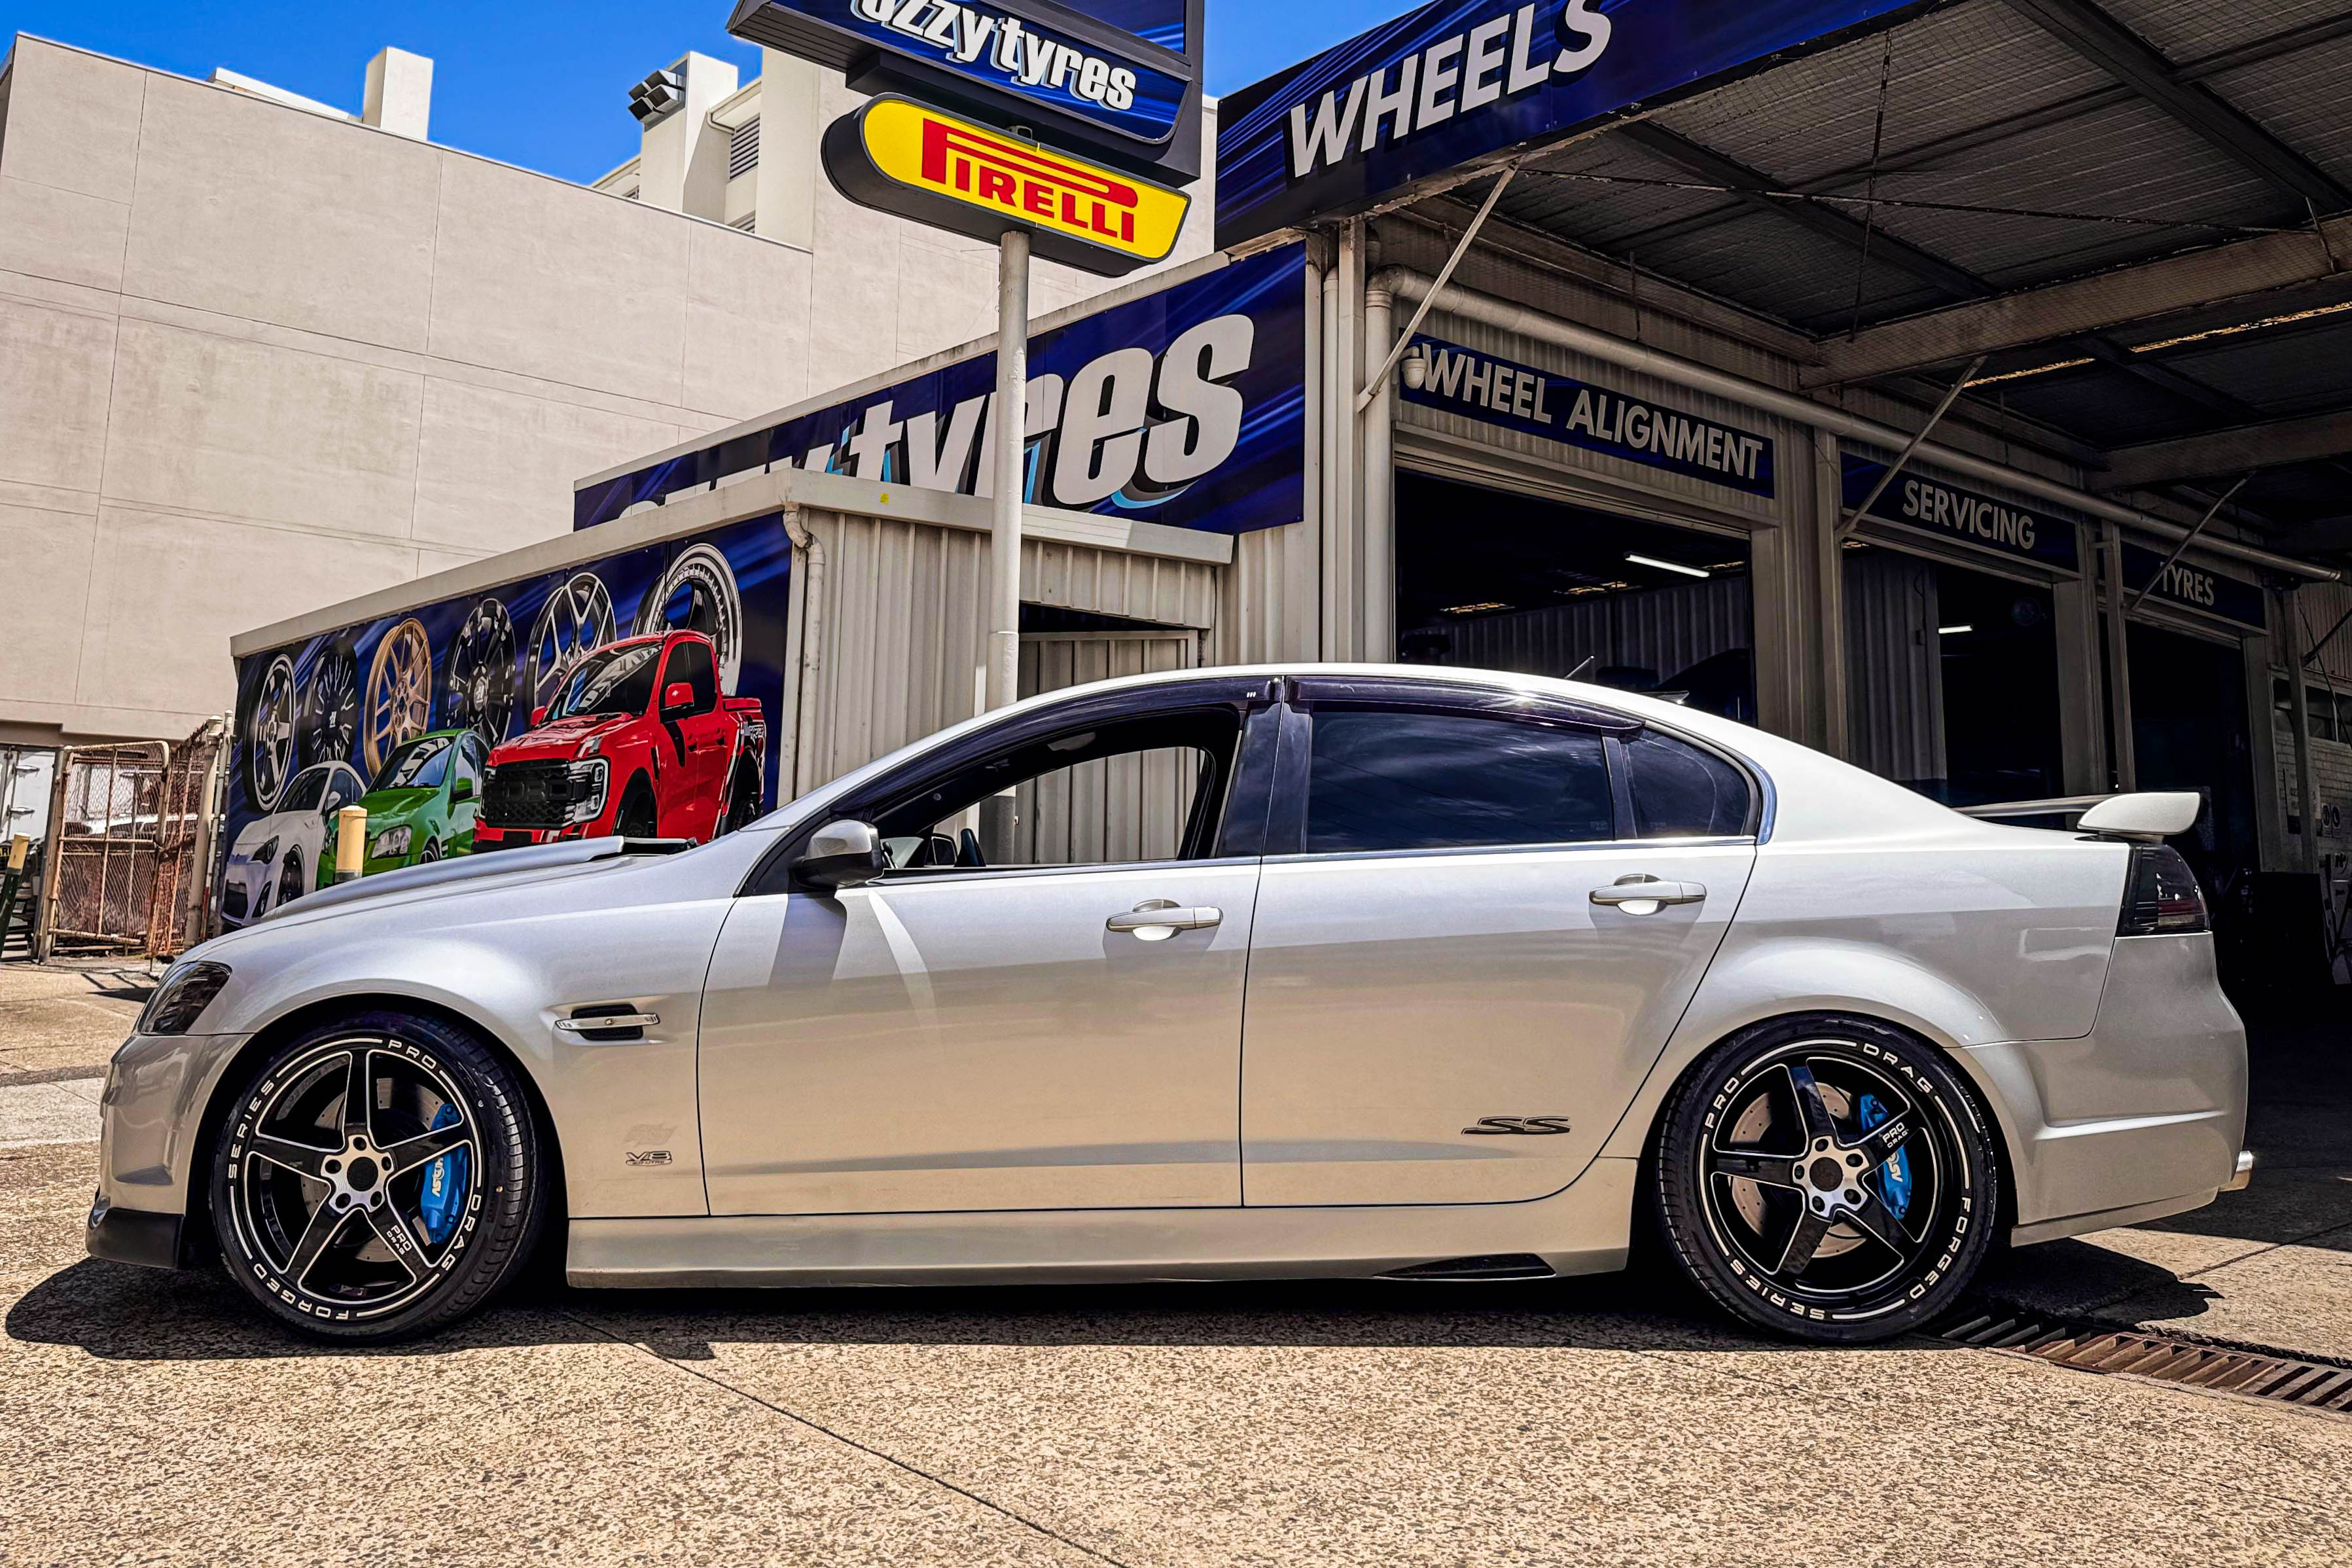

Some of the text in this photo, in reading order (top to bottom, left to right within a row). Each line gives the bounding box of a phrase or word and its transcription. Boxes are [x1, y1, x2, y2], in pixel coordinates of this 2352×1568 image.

[1291, 0, 1612, 178] WHEELS
[921, 117, 1139, 243] PIRELLI
[1421, 343, 1763, 480] WHEEL ALIGNMENT
[1902, 479, 2035, 550] SERVICING
[2160, 561, 2215, 607] TYRES
[228, 1039, 482, 1320] PRO DRAG FORGED SERIES
[1704, 1043, 1972, 1321] PRO DRAG FORGED SERIES
[1882, 1122, 1905, 1143] PRO
[391, 1224, 412, 1251] PRO
